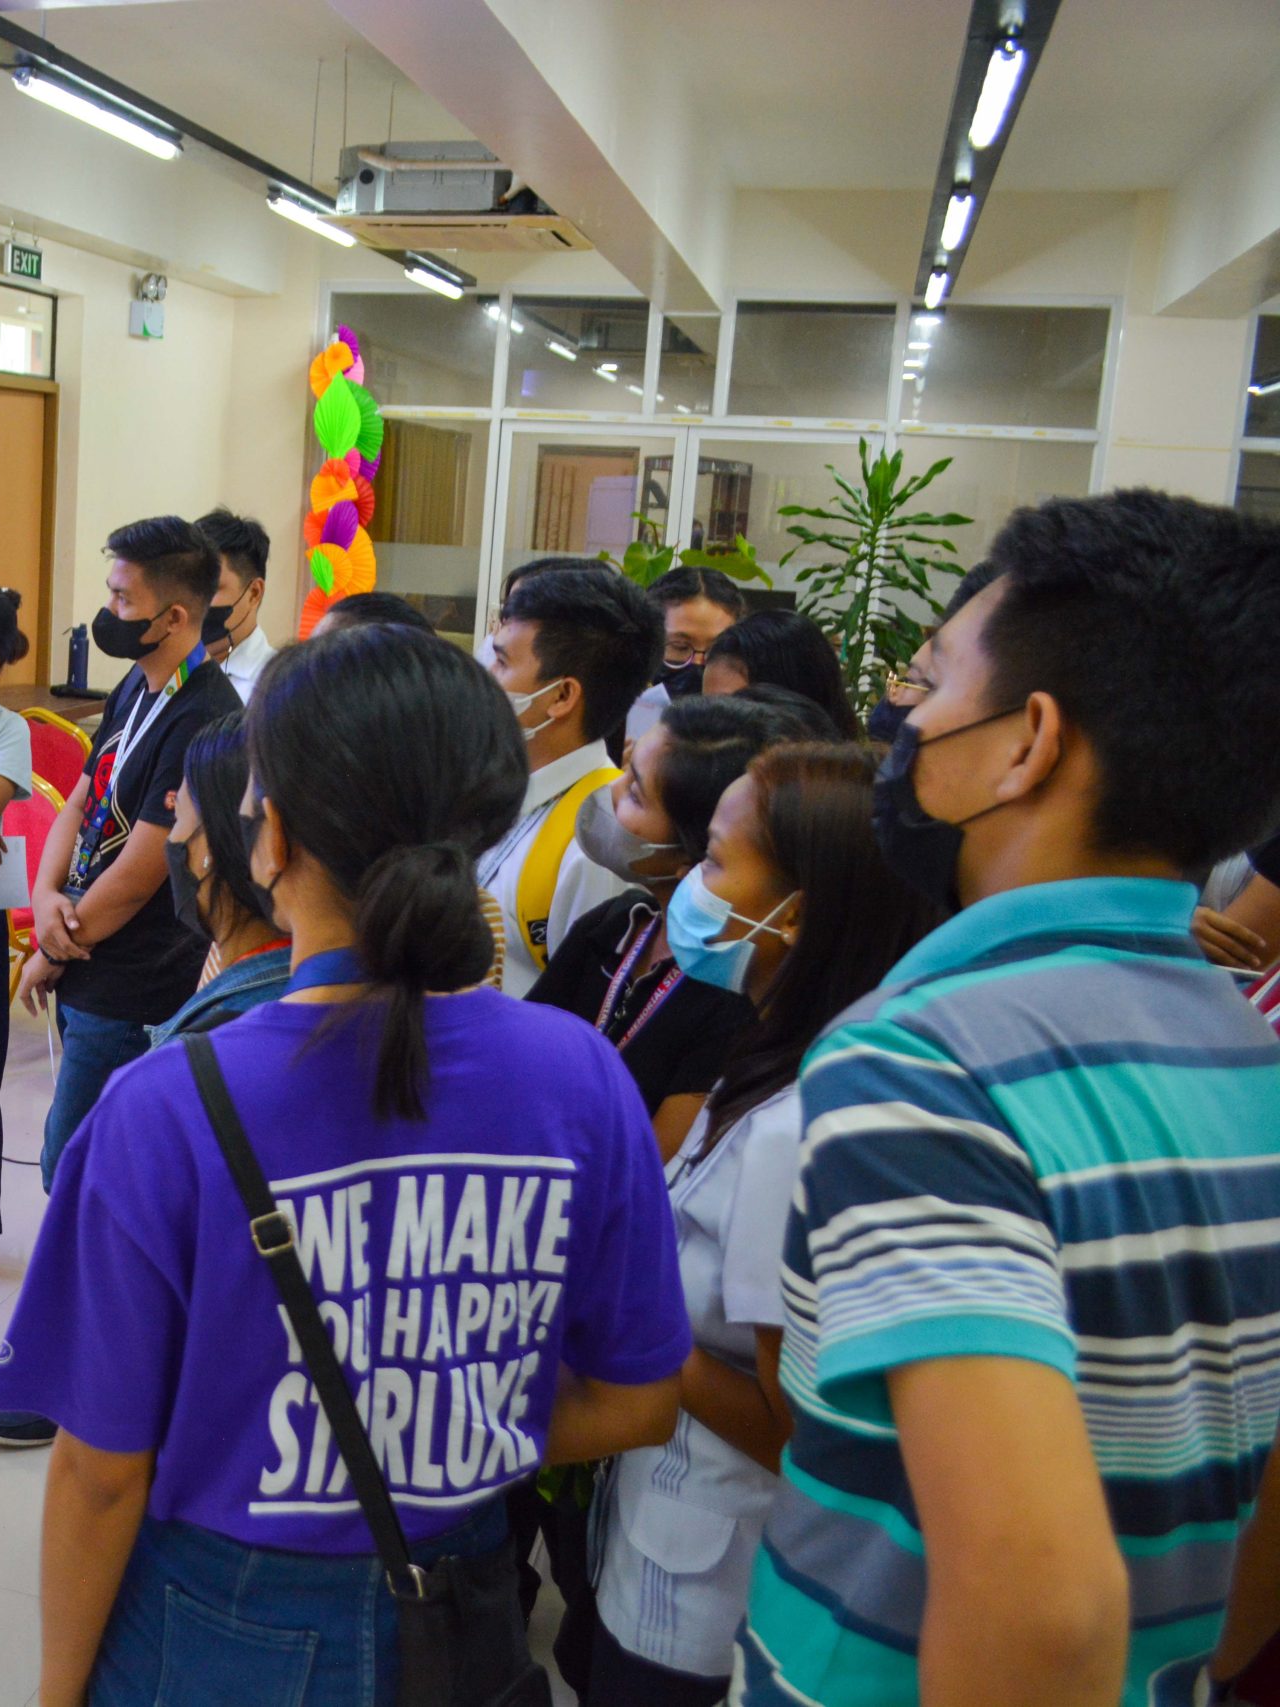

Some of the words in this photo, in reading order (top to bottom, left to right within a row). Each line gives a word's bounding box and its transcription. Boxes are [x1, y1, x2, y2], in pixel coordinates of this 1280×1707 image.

[13, 249, 39, 275] EXIT
[623, 985, 667, 1042] MEMORIAL
[275, 1181, 372, 1293] WE
[386, 1173, 573, 1280] MAKE
[381, 1279, 562, 1361] HAPPY!
